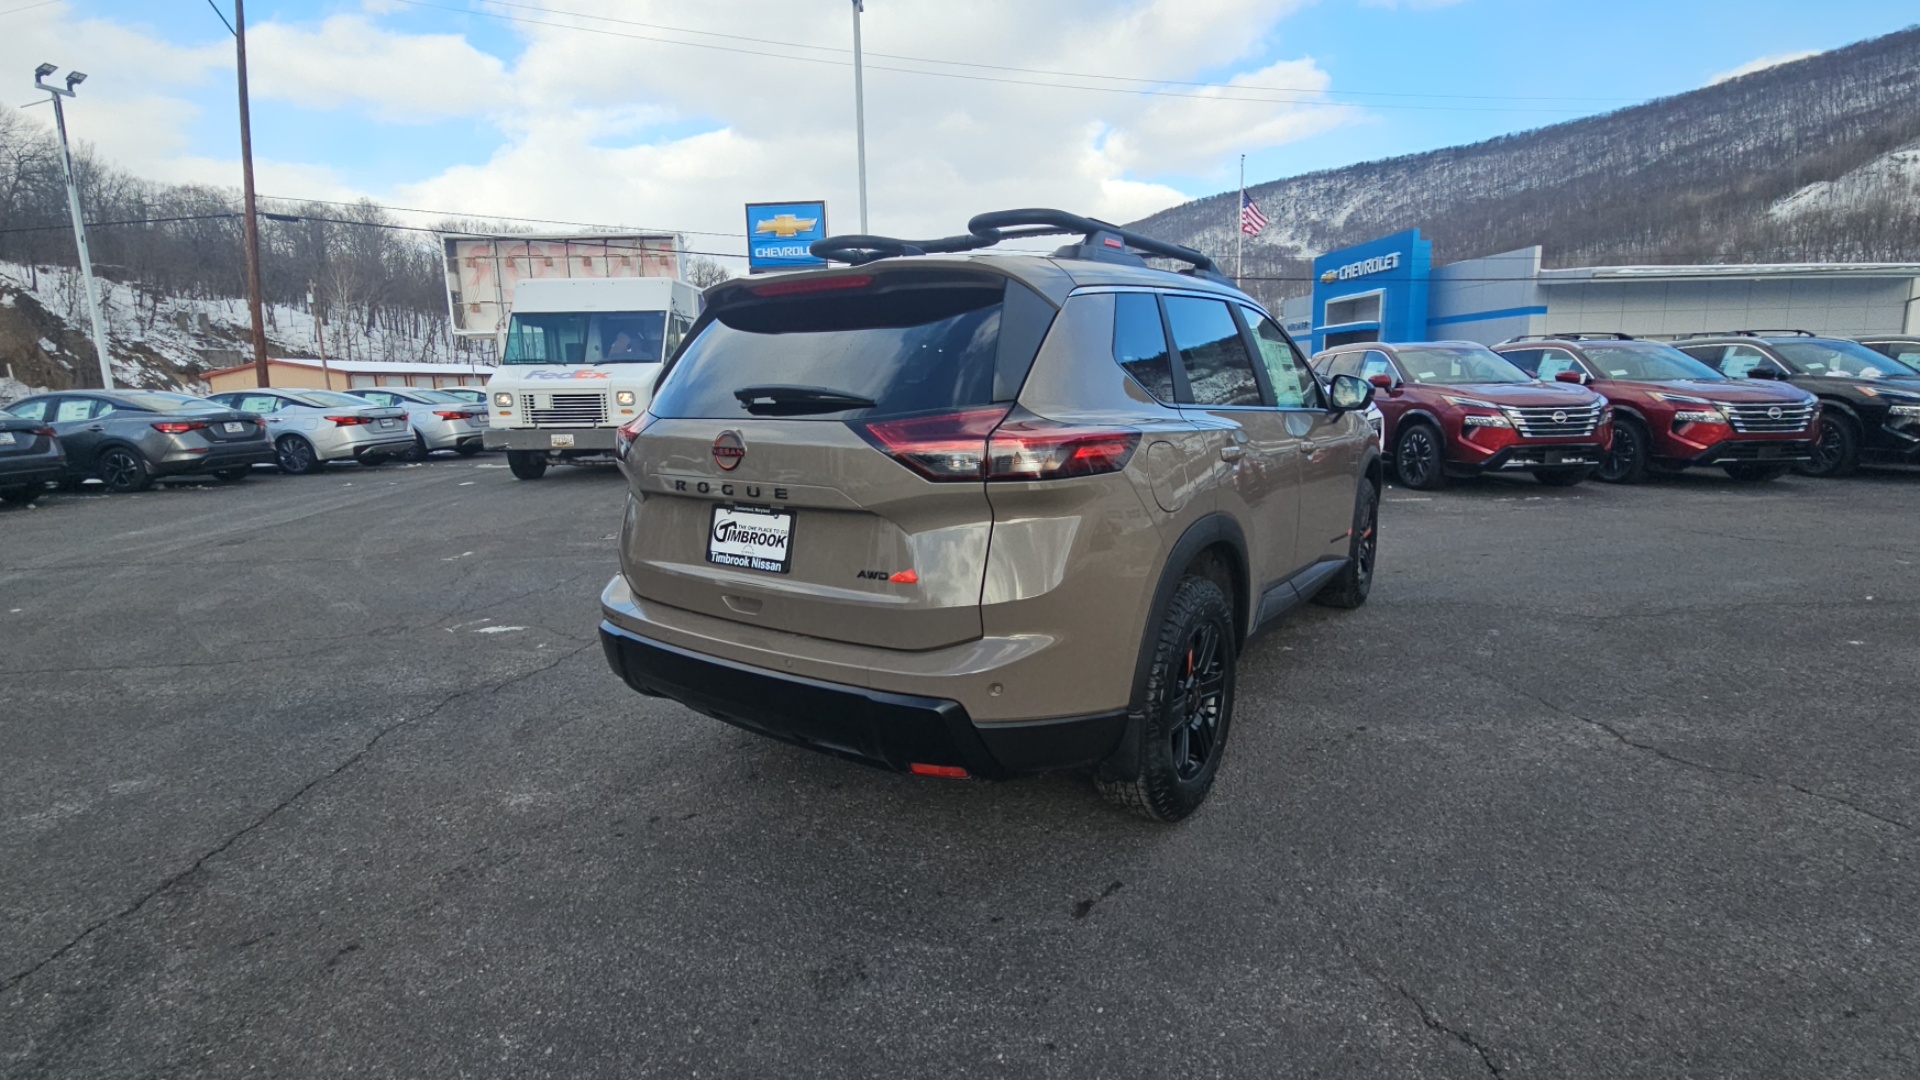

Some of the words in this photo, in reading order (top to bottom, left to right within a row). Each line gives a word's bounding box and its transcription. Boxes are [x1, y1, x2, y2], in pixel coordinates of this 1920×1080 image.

[755, 246, 812, 257] CHEVROL
[1339, 251, 1401, 280] CHEVROLET
[523, 369, 613, 380] FedEx
[712, 448, 744, 456] NISSAN
[675, 480, 788, 499] ROGUE
[714, 519, 787, 548] TIMBROOK
[711, 552, 750, 566] Timbrook
[751, 557, 781, 571] Nissan
[857, 569, 889, 581] AWD
